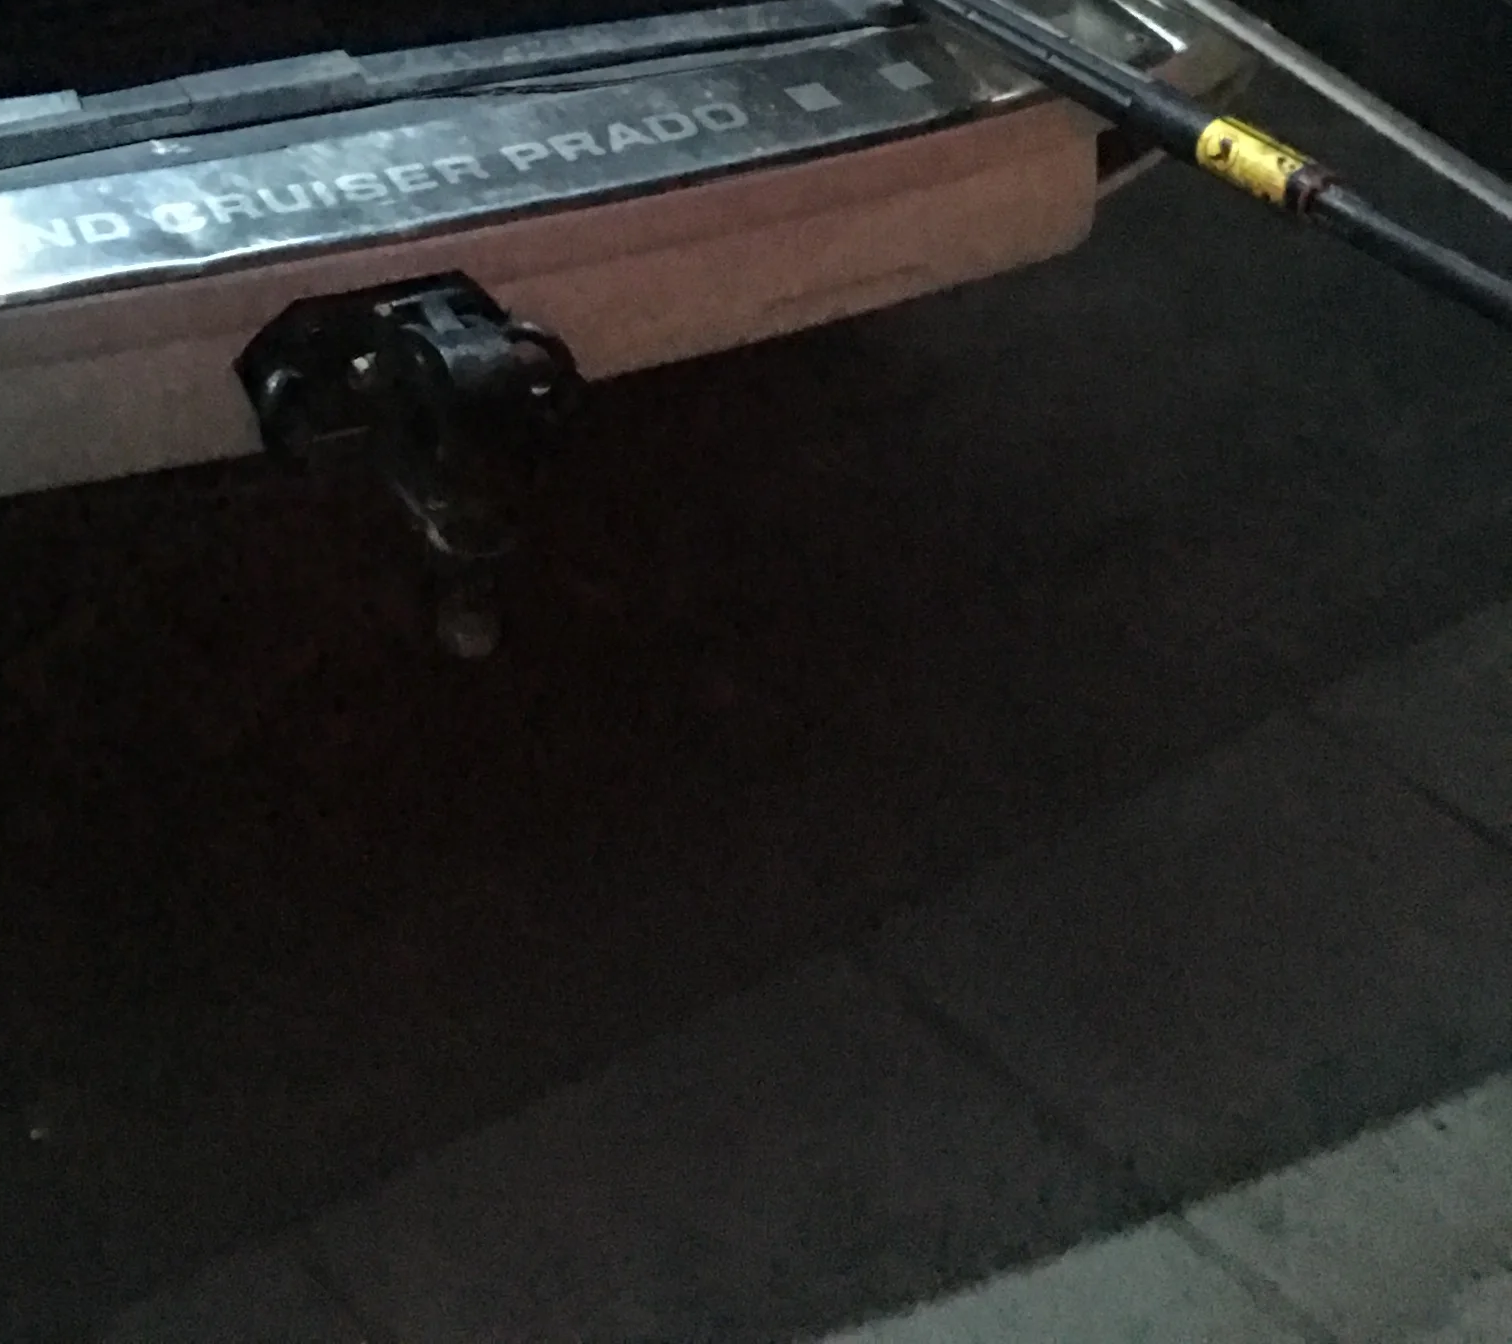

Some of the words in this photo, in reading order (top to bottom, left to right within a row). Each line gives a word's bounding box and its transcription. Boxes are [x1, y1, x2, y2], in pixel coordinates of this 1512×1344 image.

[21, 212, 130, 252] ND
[151, 154, 489, 234] CRUISER
[500, 102, 748, 171] PRADO
